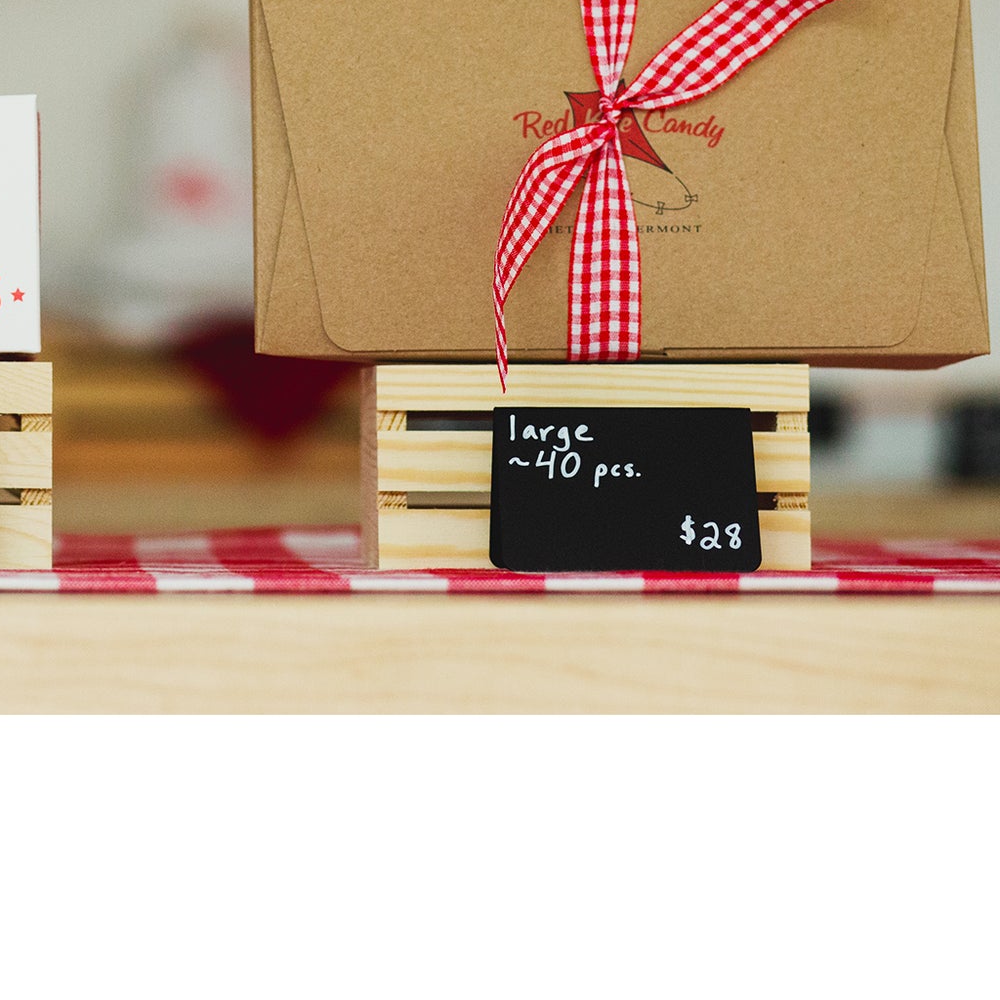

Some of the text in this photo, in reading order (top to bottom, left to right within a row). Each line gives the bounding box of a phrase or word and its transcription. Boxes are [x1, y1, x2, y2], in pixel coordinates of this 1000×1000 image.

[512, 107, 726, 149] Red Ke Candy
[638, 224, 703, 235] ERMONT
[509, 414, 594, 452] large
[593, 463, 642, 488] pcs.
[679, 515, 743, 551] $28
